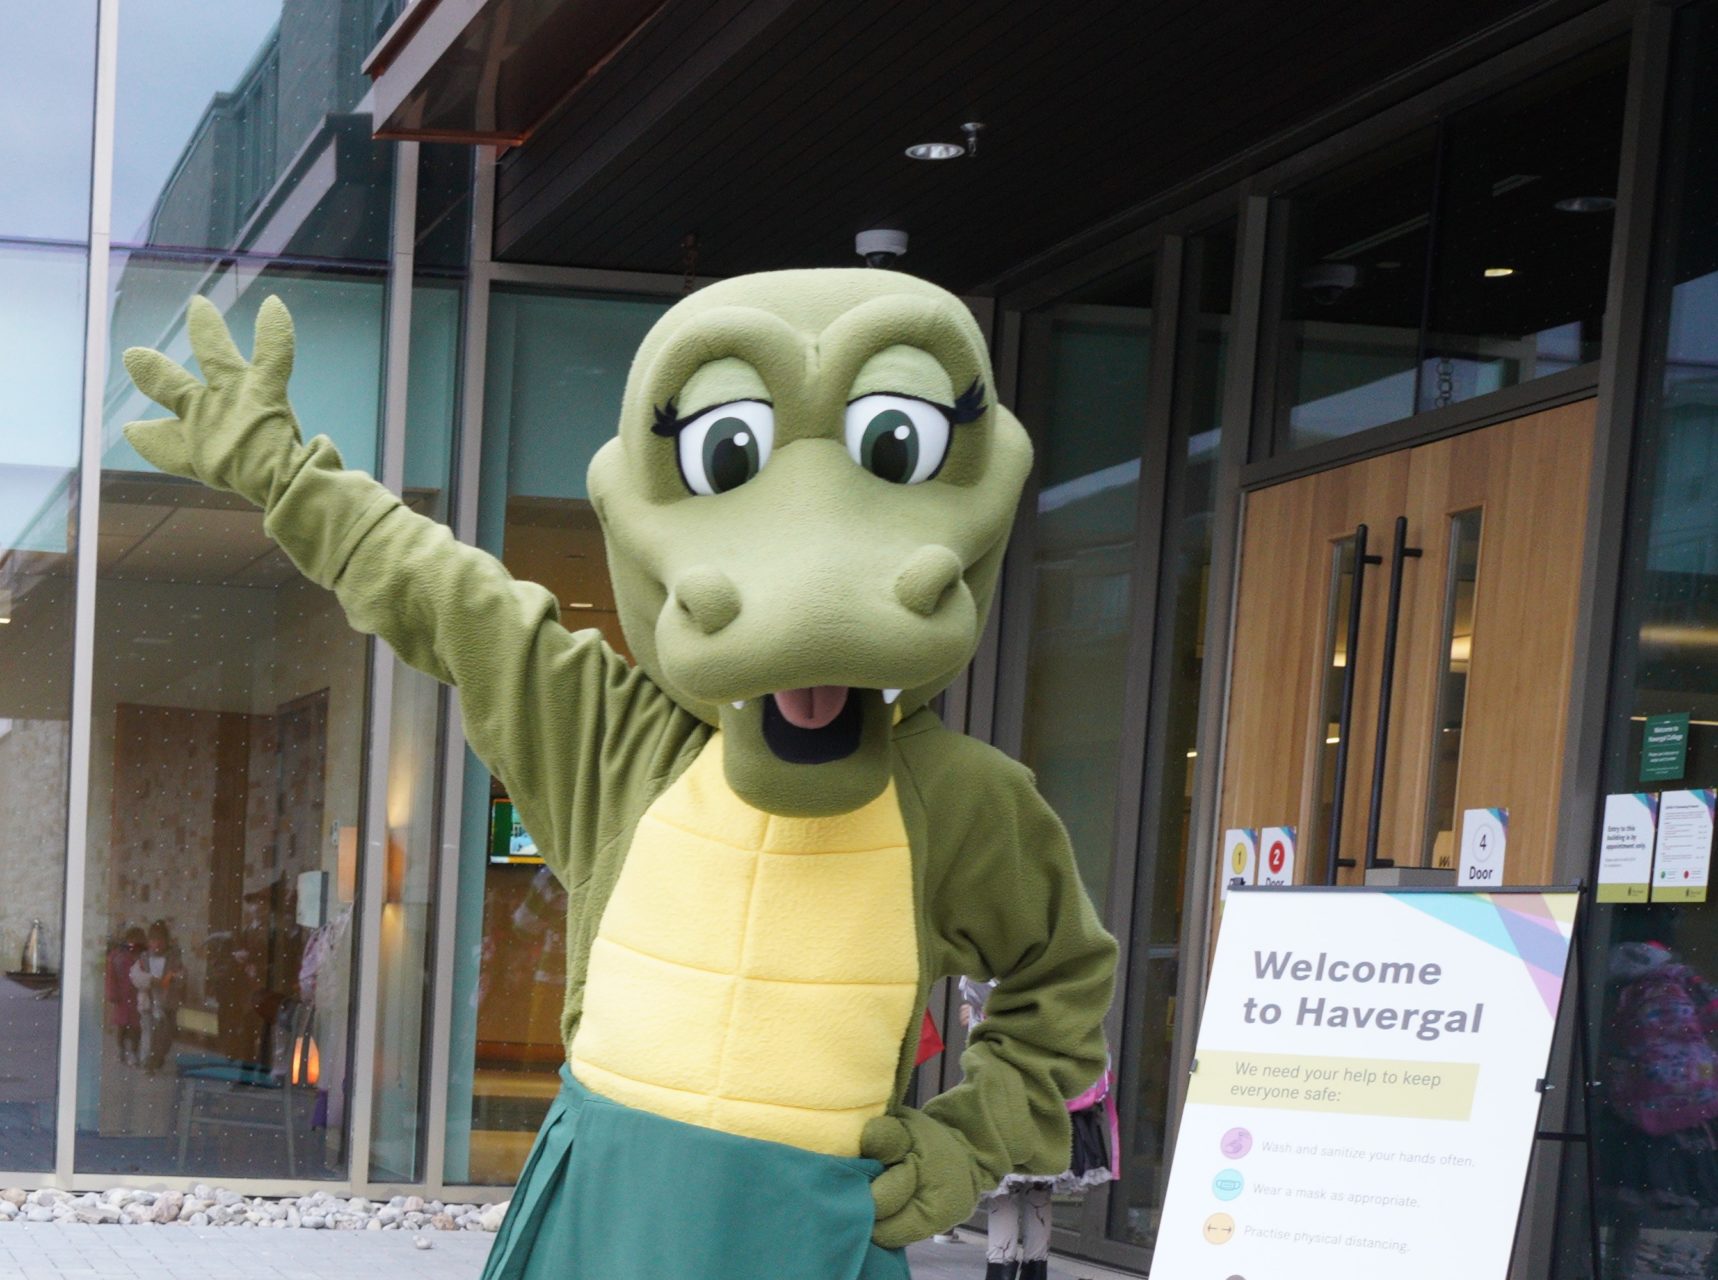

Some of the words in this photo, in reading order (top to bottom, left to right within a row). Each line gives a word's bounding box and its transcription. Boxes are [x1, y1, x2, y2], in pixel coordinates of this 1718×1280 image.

[1479, 834, 1487, 851] 4
[1273, 849, 1281, 865] 2
[1469, 866, 1493, 880] Door
[1254, 950, 1442, 985] Welcome
[1243, 997, 1282, 1025] to
[1296, 997, 1484, 1041] Havergal
[1235, 1061, 1258, 1076] We
[1262, 1064, 1301, 1079] need
[1304, 1067, 1340, 1083] your
[1343, 1067, 1378, 1087] help
[1382, 1072, 1399, 1085] to
[1403, 1071, 1442, 1091] keep
[1230, 1084, 1300, 1101] everyone
[1303, 1087, 1341, 1102] safe:
[1262, 1140, 1292, 1154] Wash
[1296, 1143, 1318, 1156] and
[1320, 1145, 1366, 1161] sanitize
[1368, 1149, 1397, 1163] your
[1399, 1150, 1436, 1165] hands
[1439, 1153, 1476, 1168] often.
[1252, 1182, 1283, 1196] Wear
[1284, 1187, 1293, 1197] a
[1295, 1186, 1327, 1200] mask
[1330, 1191, 1344, 1202] as
[1347, 1192, 1422, 1209] appropriate.
[1243, 1225, 1291, 1240] Practise
[1294, 1229, 1343, 1246] physical
[1345, 1235, 1411, 1254] distancing.
